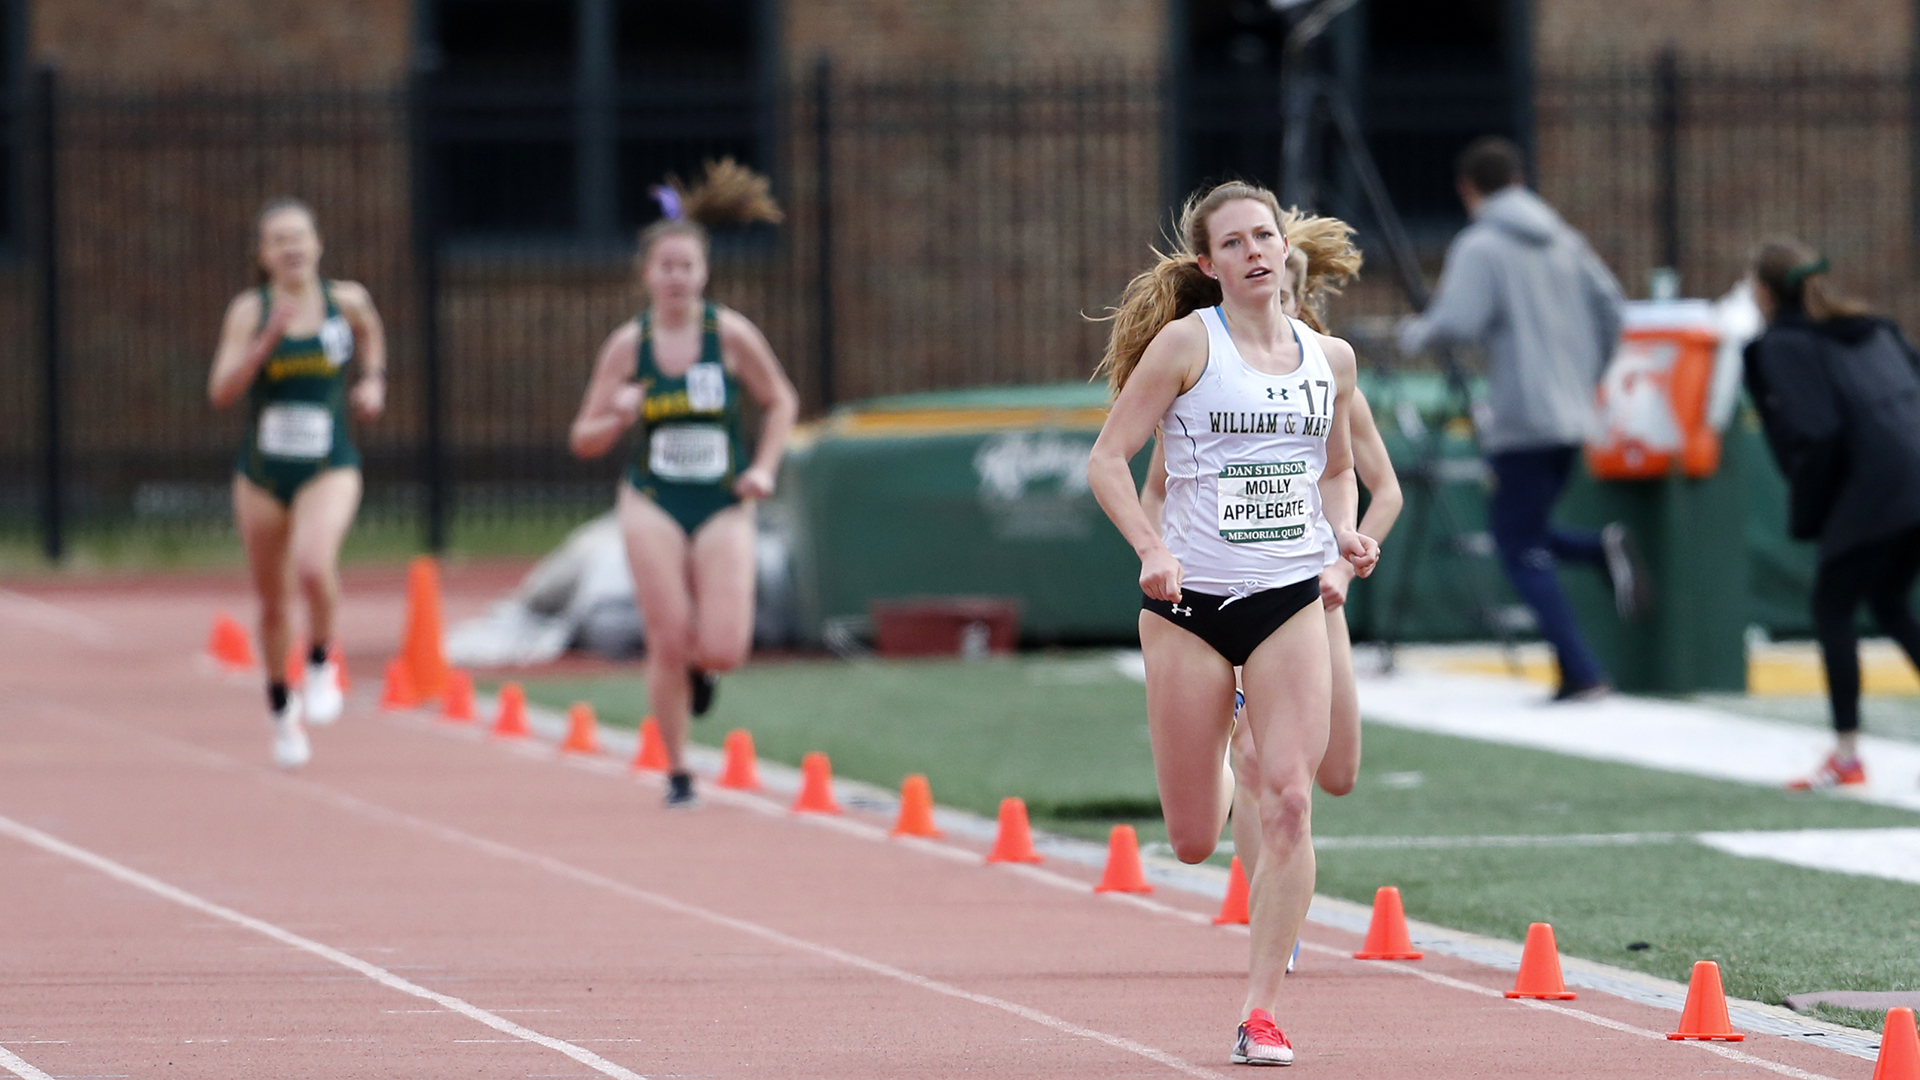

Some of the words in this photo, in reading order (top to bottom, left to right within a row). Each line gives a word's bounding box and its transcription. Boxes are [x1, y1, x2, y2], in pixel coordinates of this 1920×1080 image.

[1299, 379, 1329, 416] 17
[1209, 411, 1279, 433] WILLIAM
[1284, 413, 1296, 434] &
[1227, 466, 1253, 476] DAN
[1255, 462, 1304, 475] STIMSON
[1245, 479, 1291, 495] MOLLY
[1223, 499, 1305, 520] APPLEGATE
[1228, 530, 1280, 540] MEMORIAL
[1281, 527, 1303, 539] QUAD
